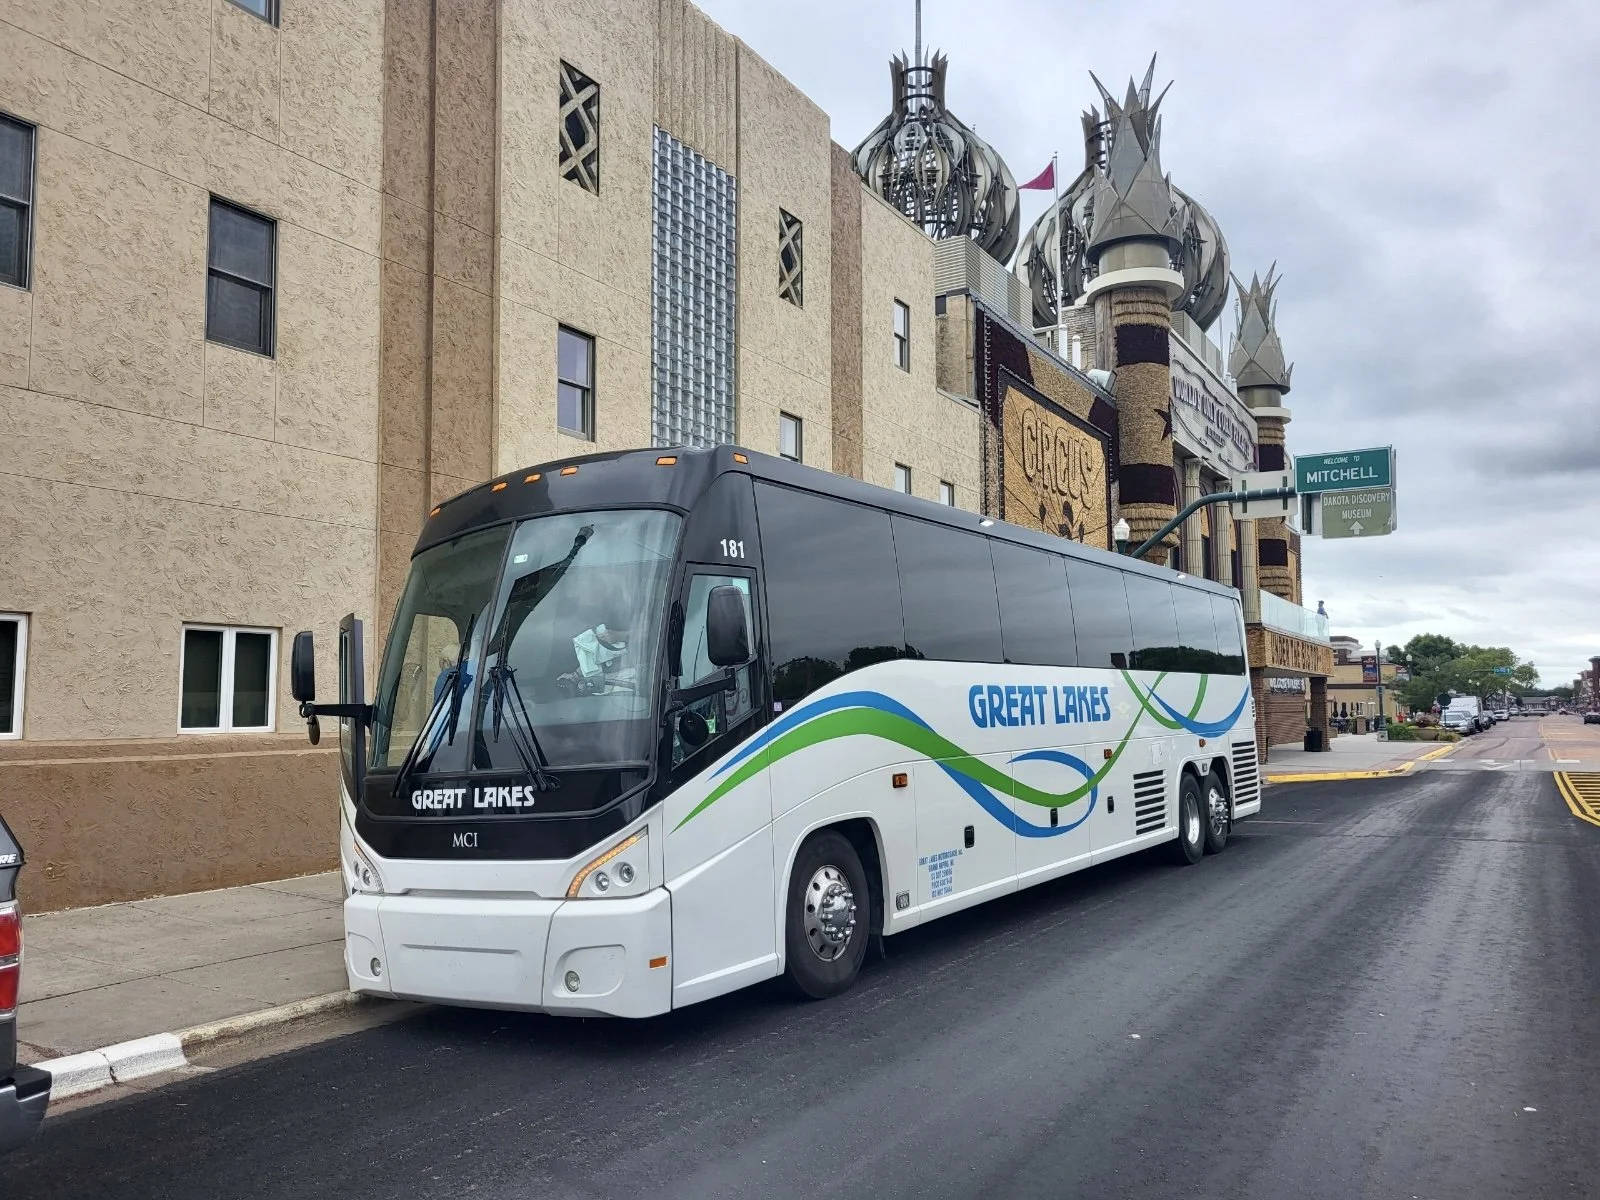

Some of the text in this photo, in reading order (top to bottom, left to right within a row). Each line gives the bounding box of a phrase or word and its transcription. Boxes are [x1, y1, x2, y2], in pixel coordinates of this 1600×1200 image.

[1022, 408, 1093, 510] CIRCUS
[1323, 456, 1348, 465] WELCOME
[1306, 466, 1379, 484] MITCHELL
[1323, 492, 1390, 507] DAKOTA DISCOVERY
[1341, 508, 1372, 520] MUSEUM
[720, 538, 745, 559] 181
[968, 685, 1111, 728] GREAT LAKES
[411, 786, 535, 810] GREAT LAKES
[452, 832, 478, 848] MCI
